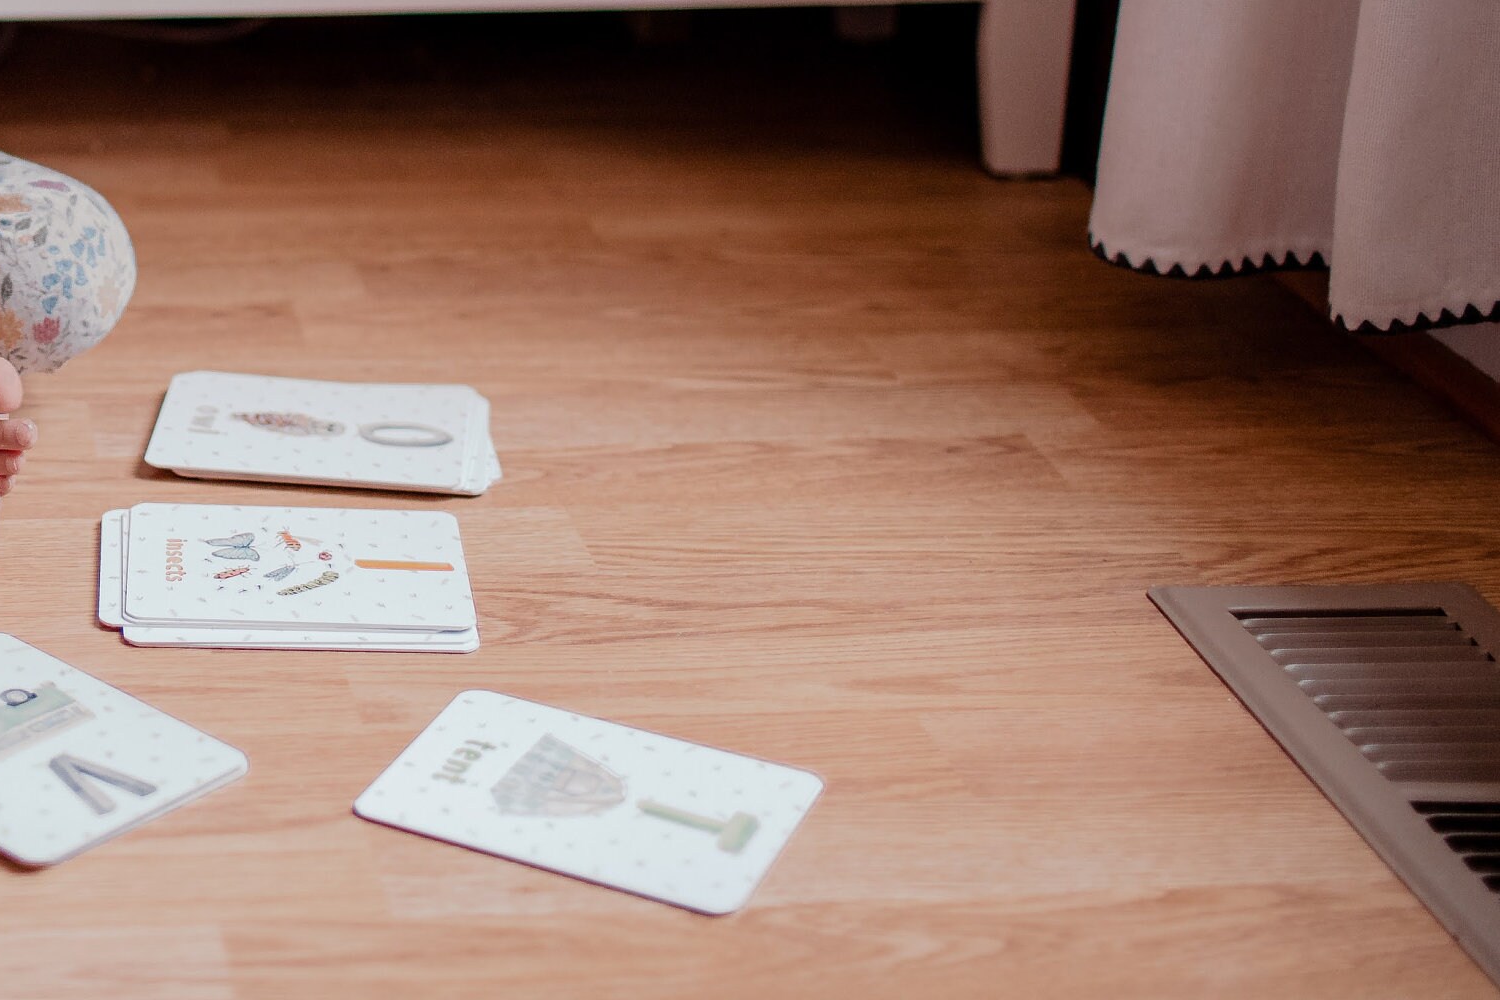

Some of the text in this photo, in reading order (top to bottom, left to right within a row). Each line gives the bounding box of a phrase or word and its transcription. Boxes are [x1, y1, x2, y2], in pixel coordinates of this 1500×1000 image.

[165, 537, 189, 583] insects
[48, 753, 157, 816] V
[432, 738, 498, 785] tent
[636, 799, 760, 854] T
